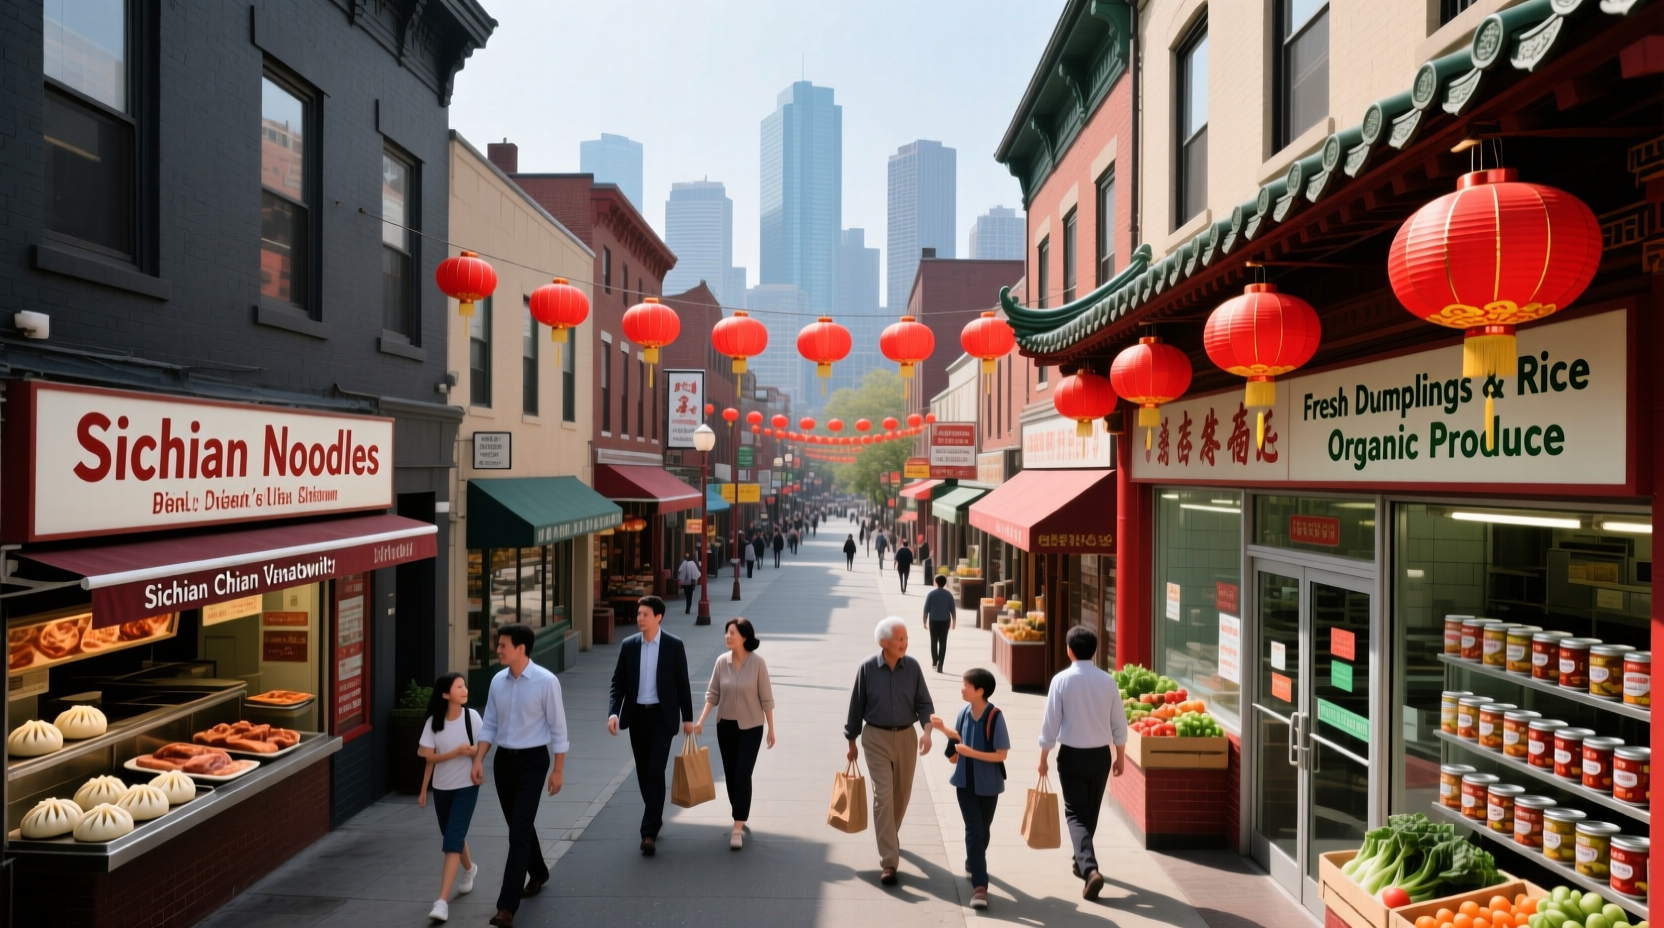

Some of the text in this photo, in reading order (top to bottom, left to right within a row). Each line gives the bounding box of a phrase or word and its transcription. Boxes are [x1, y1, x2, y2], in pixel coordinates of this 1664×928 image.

[1304, 350, 1591, 421] Fresh Dumplings & Rice
[73, 411, 380, 482] Sichian Noodles
[1328, 423, 1419, 471] Organic
[1430, 415, 1565, 459] Produce
[145, 580, 208, 609] Sichian
[214, 571, 259, 597] Chian
